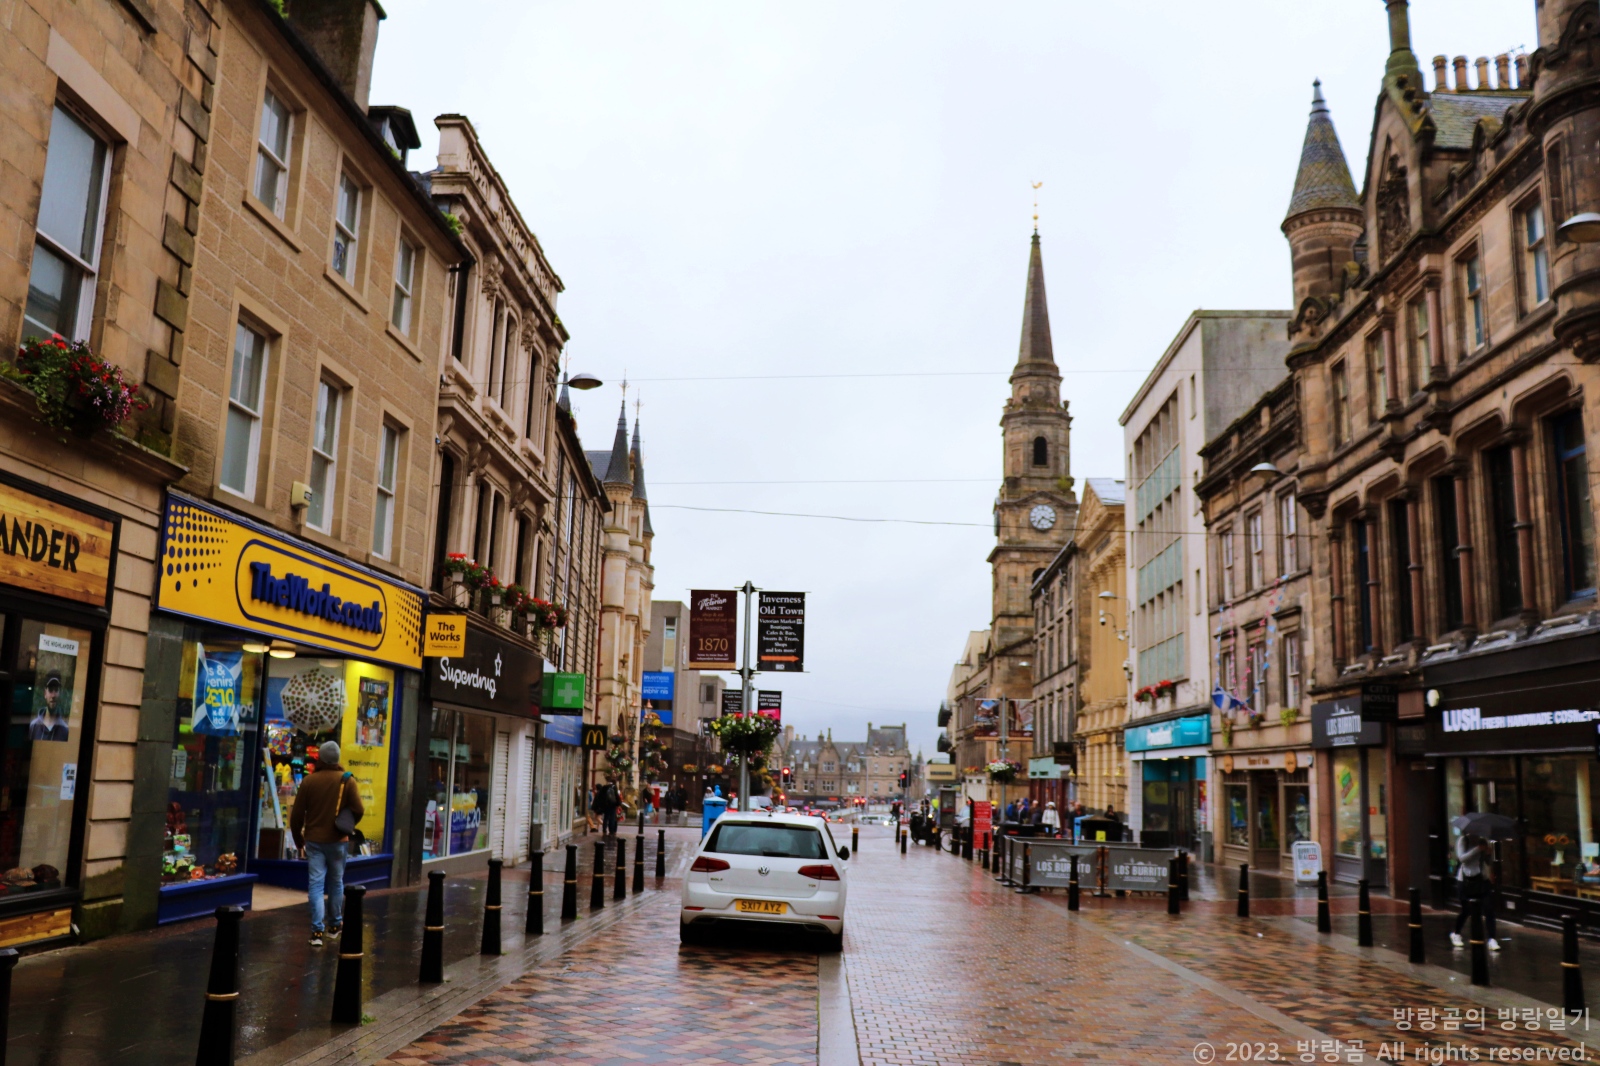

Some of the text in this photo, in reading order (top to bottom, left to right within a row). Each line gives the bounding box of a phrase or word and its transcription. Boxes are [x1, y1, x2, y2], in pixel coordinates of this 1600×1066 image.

[250, 561, 383, 635] TheWorks.co.uk
[762, 594, 802, 603] Inverness
[759, 605, 804, 615] Old Town
[437, 621, 456, 632] The
[430, 632, 461, 642] Works
[699, 638, 728, 651] 1870
[440, 656, 497, 700] Superdrug
[1326, 714, 1361, 736] LOS BURRITO
[1442, 707, 1481, 732] LUSH
[1481, 716, 1506, 730] FRESH
[1507, 711, 1553, 728] HANDMADE
[1036, 861, 1053, 872] LOS
[1114, 864, 1168, 877] LOS BURRITO
[741, 900, 782, 912] SX17 AYZ
